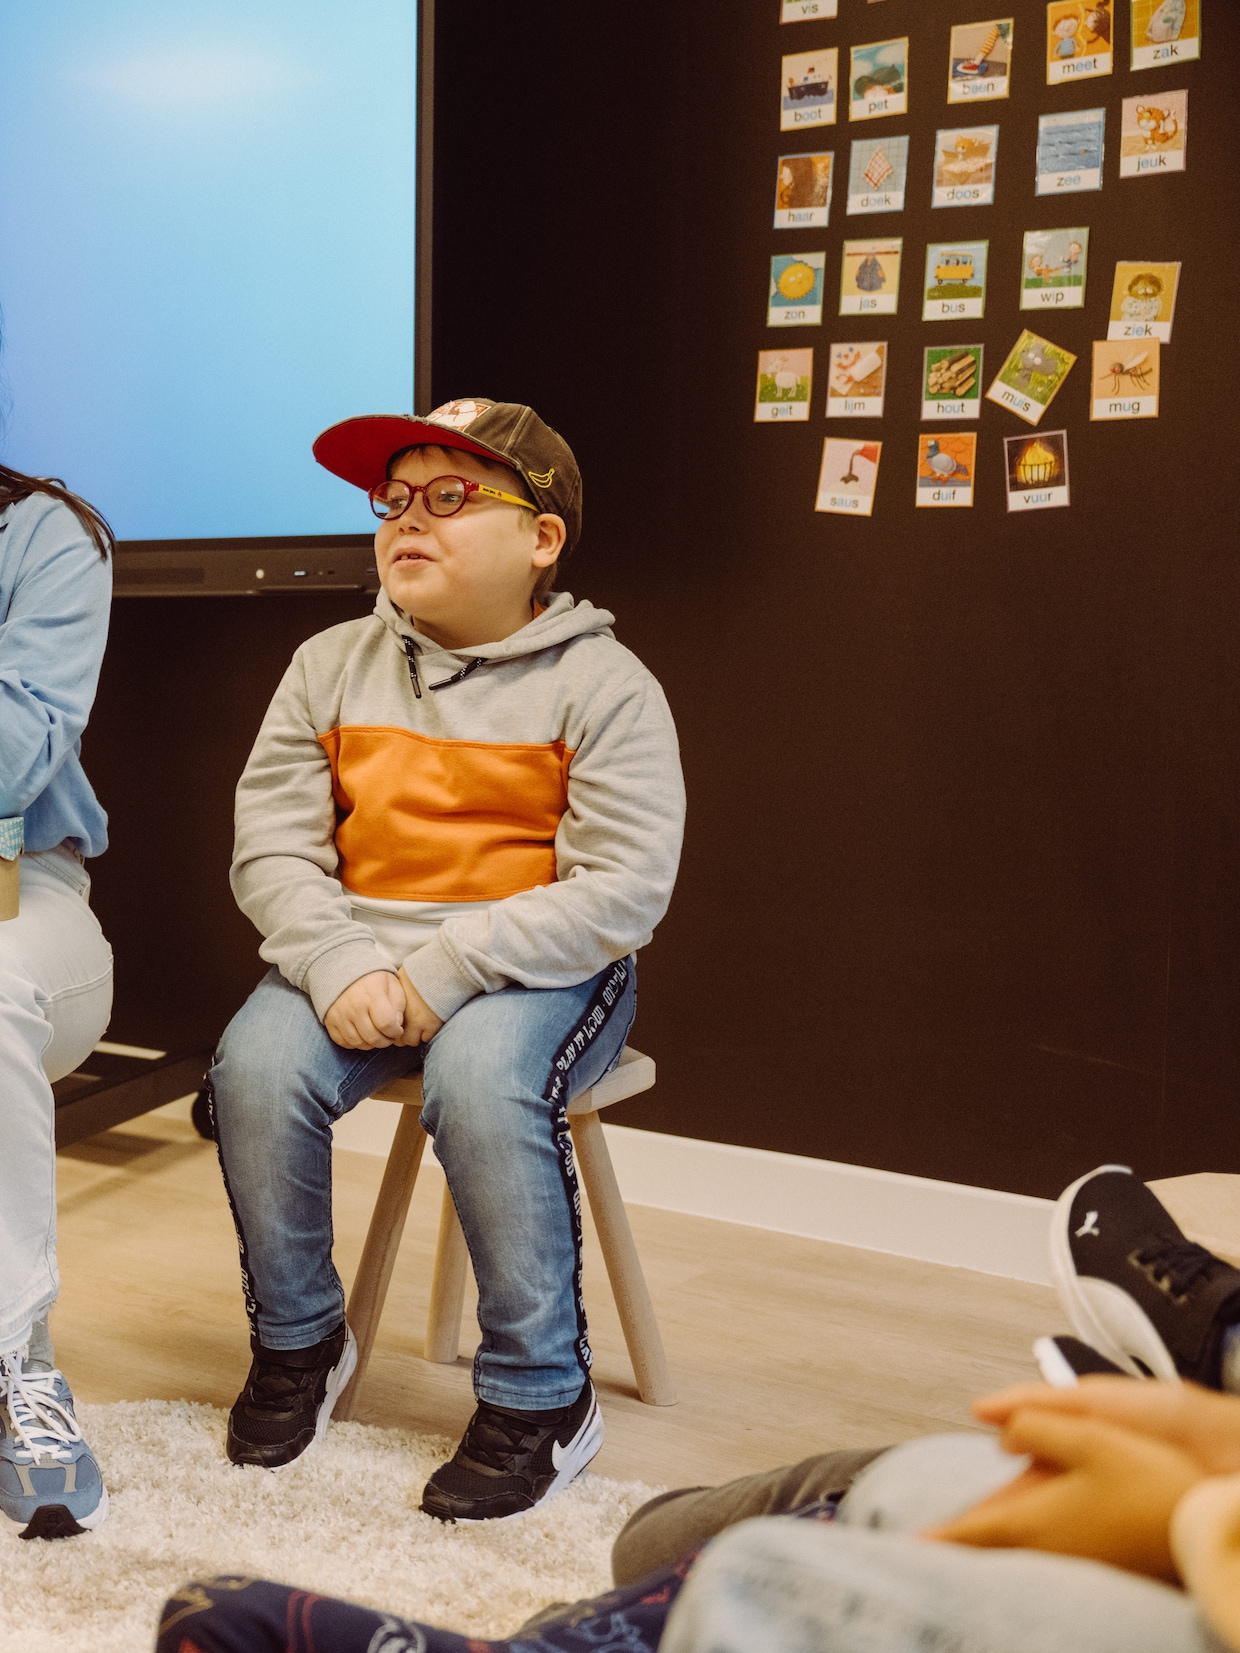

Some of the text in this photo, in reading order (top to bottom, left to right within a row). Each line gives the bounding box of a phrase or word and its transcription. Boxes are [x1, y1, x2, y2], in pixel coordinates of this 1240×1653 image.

[802, 3, 818, 14] vis
[1153, 43, 1178, 60] zak
[1062, 58, 1097, 74] meet
[962, 80, 995, 95] been
[869, 99, 888, 114] pet
[794, 108, 822, 121] boot
[1137, 153, 1166, 171] jeuk
[1057, 173, 1081, 186] zee
[947, 186, 979, 200] doos
[861, 194, 891, 207] doek
[788, 210, 813, 223] haar
[1041, 290, 1065, 305] wip
[860, 297, 877, 312] jas
[942, 300, 965, 313] bus
[785, 309, 804, 320] zon
[1124, 323, 1152, 336] ziek
[844, 399, 865, 414] lijm
[937, 401, 965, 414] hout
[1002, 389, 1031, 413] muis
[1109, 400, 1140, 414] mug
[771, 405, 792, 419] geit
[933, 490, 956, 502] duif
[1024, 491, 1052, 504] vuur
[830, 497, 858, 509] saus
